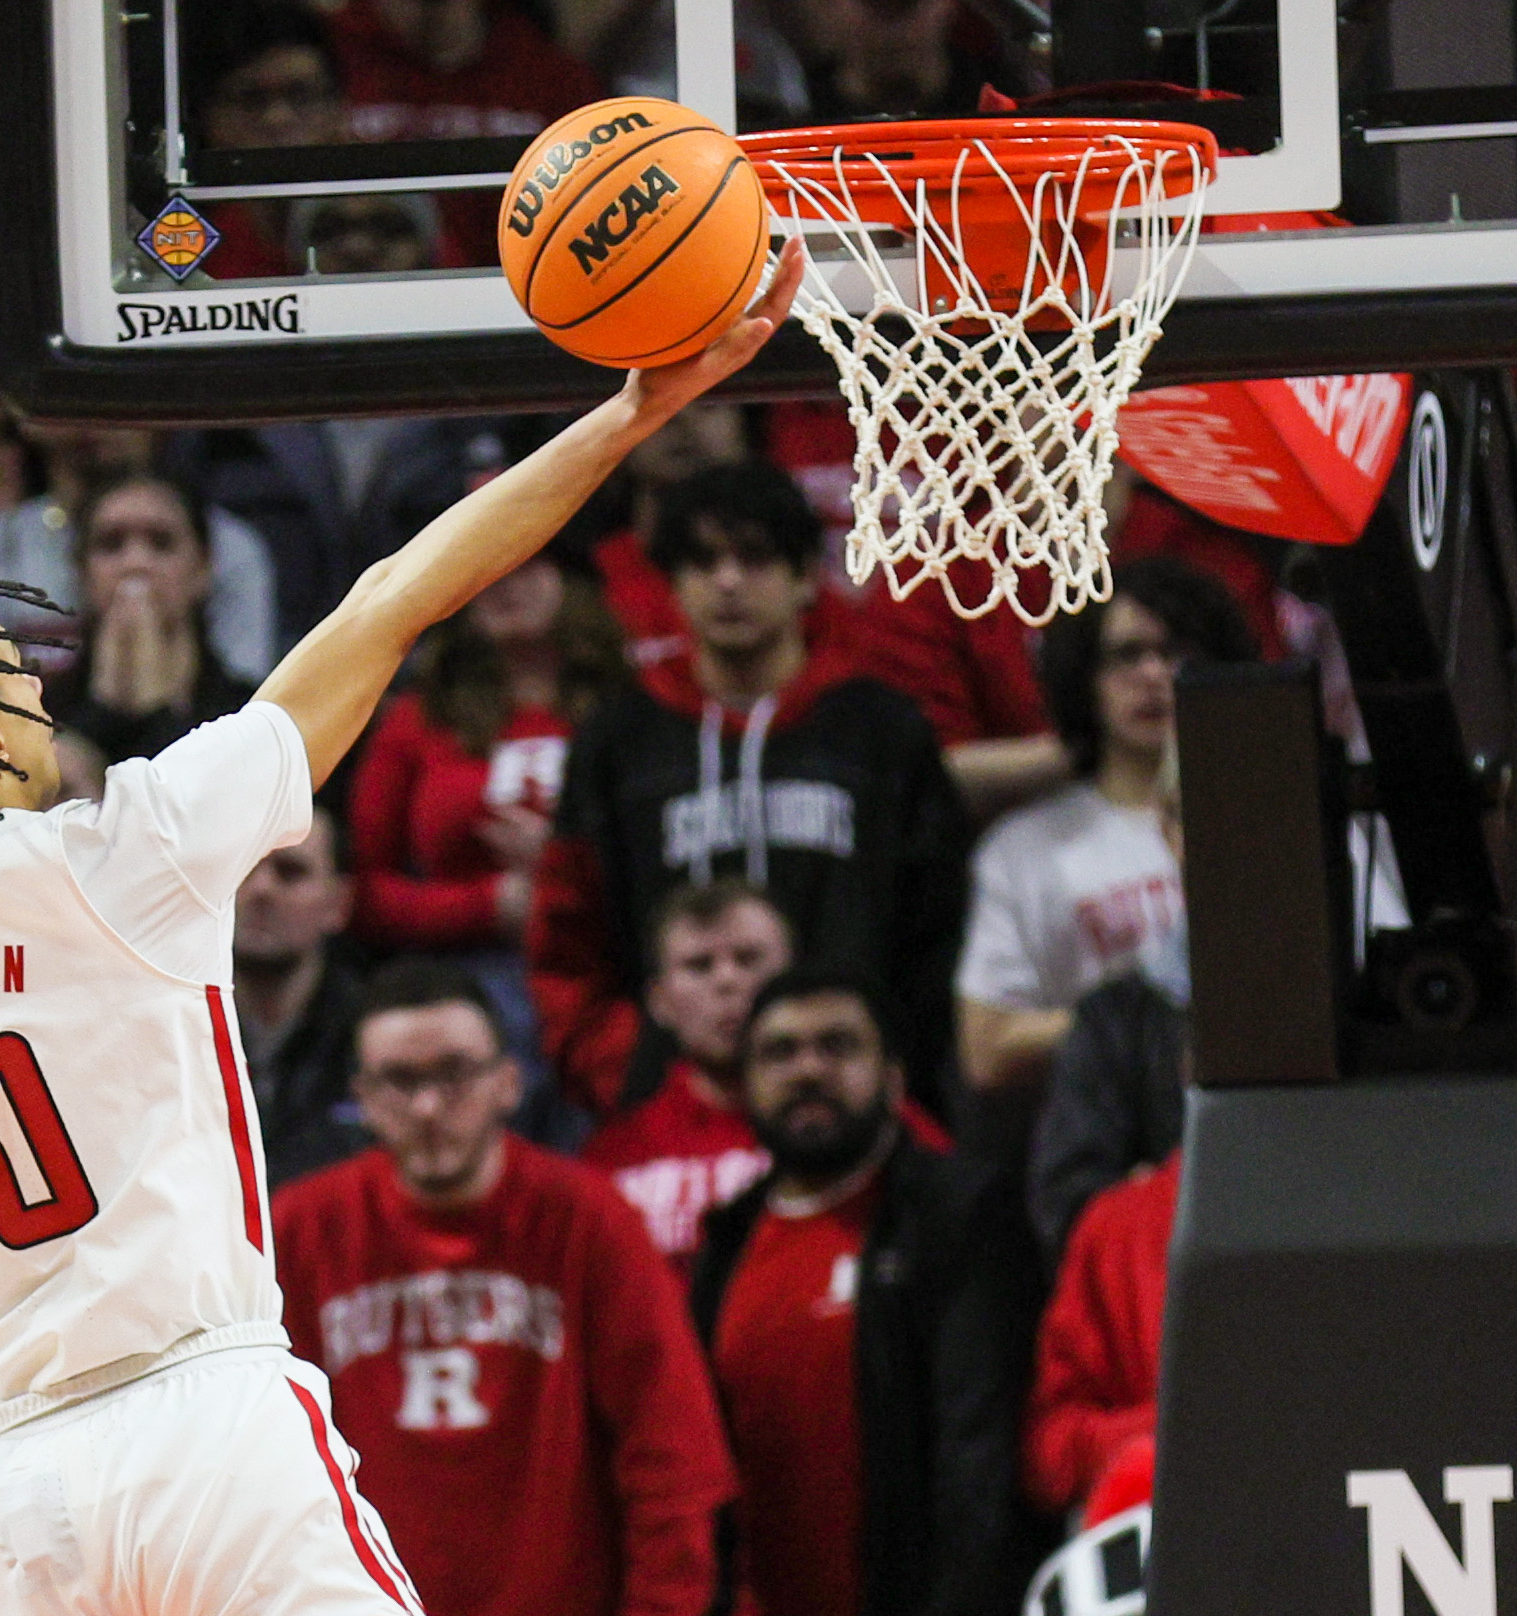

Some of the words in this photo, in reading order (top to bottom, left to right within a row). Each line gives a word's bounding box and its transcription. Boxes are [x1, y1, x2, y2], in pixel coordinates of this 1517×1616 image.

[507, 111, 653, 238] Wilson
[156, 230, 201, 248] NIT
[567, 165, 680, 276] NCAA
[117, 293, 299, 342] SPALDING
[395, 1347, 490, 1430] R
